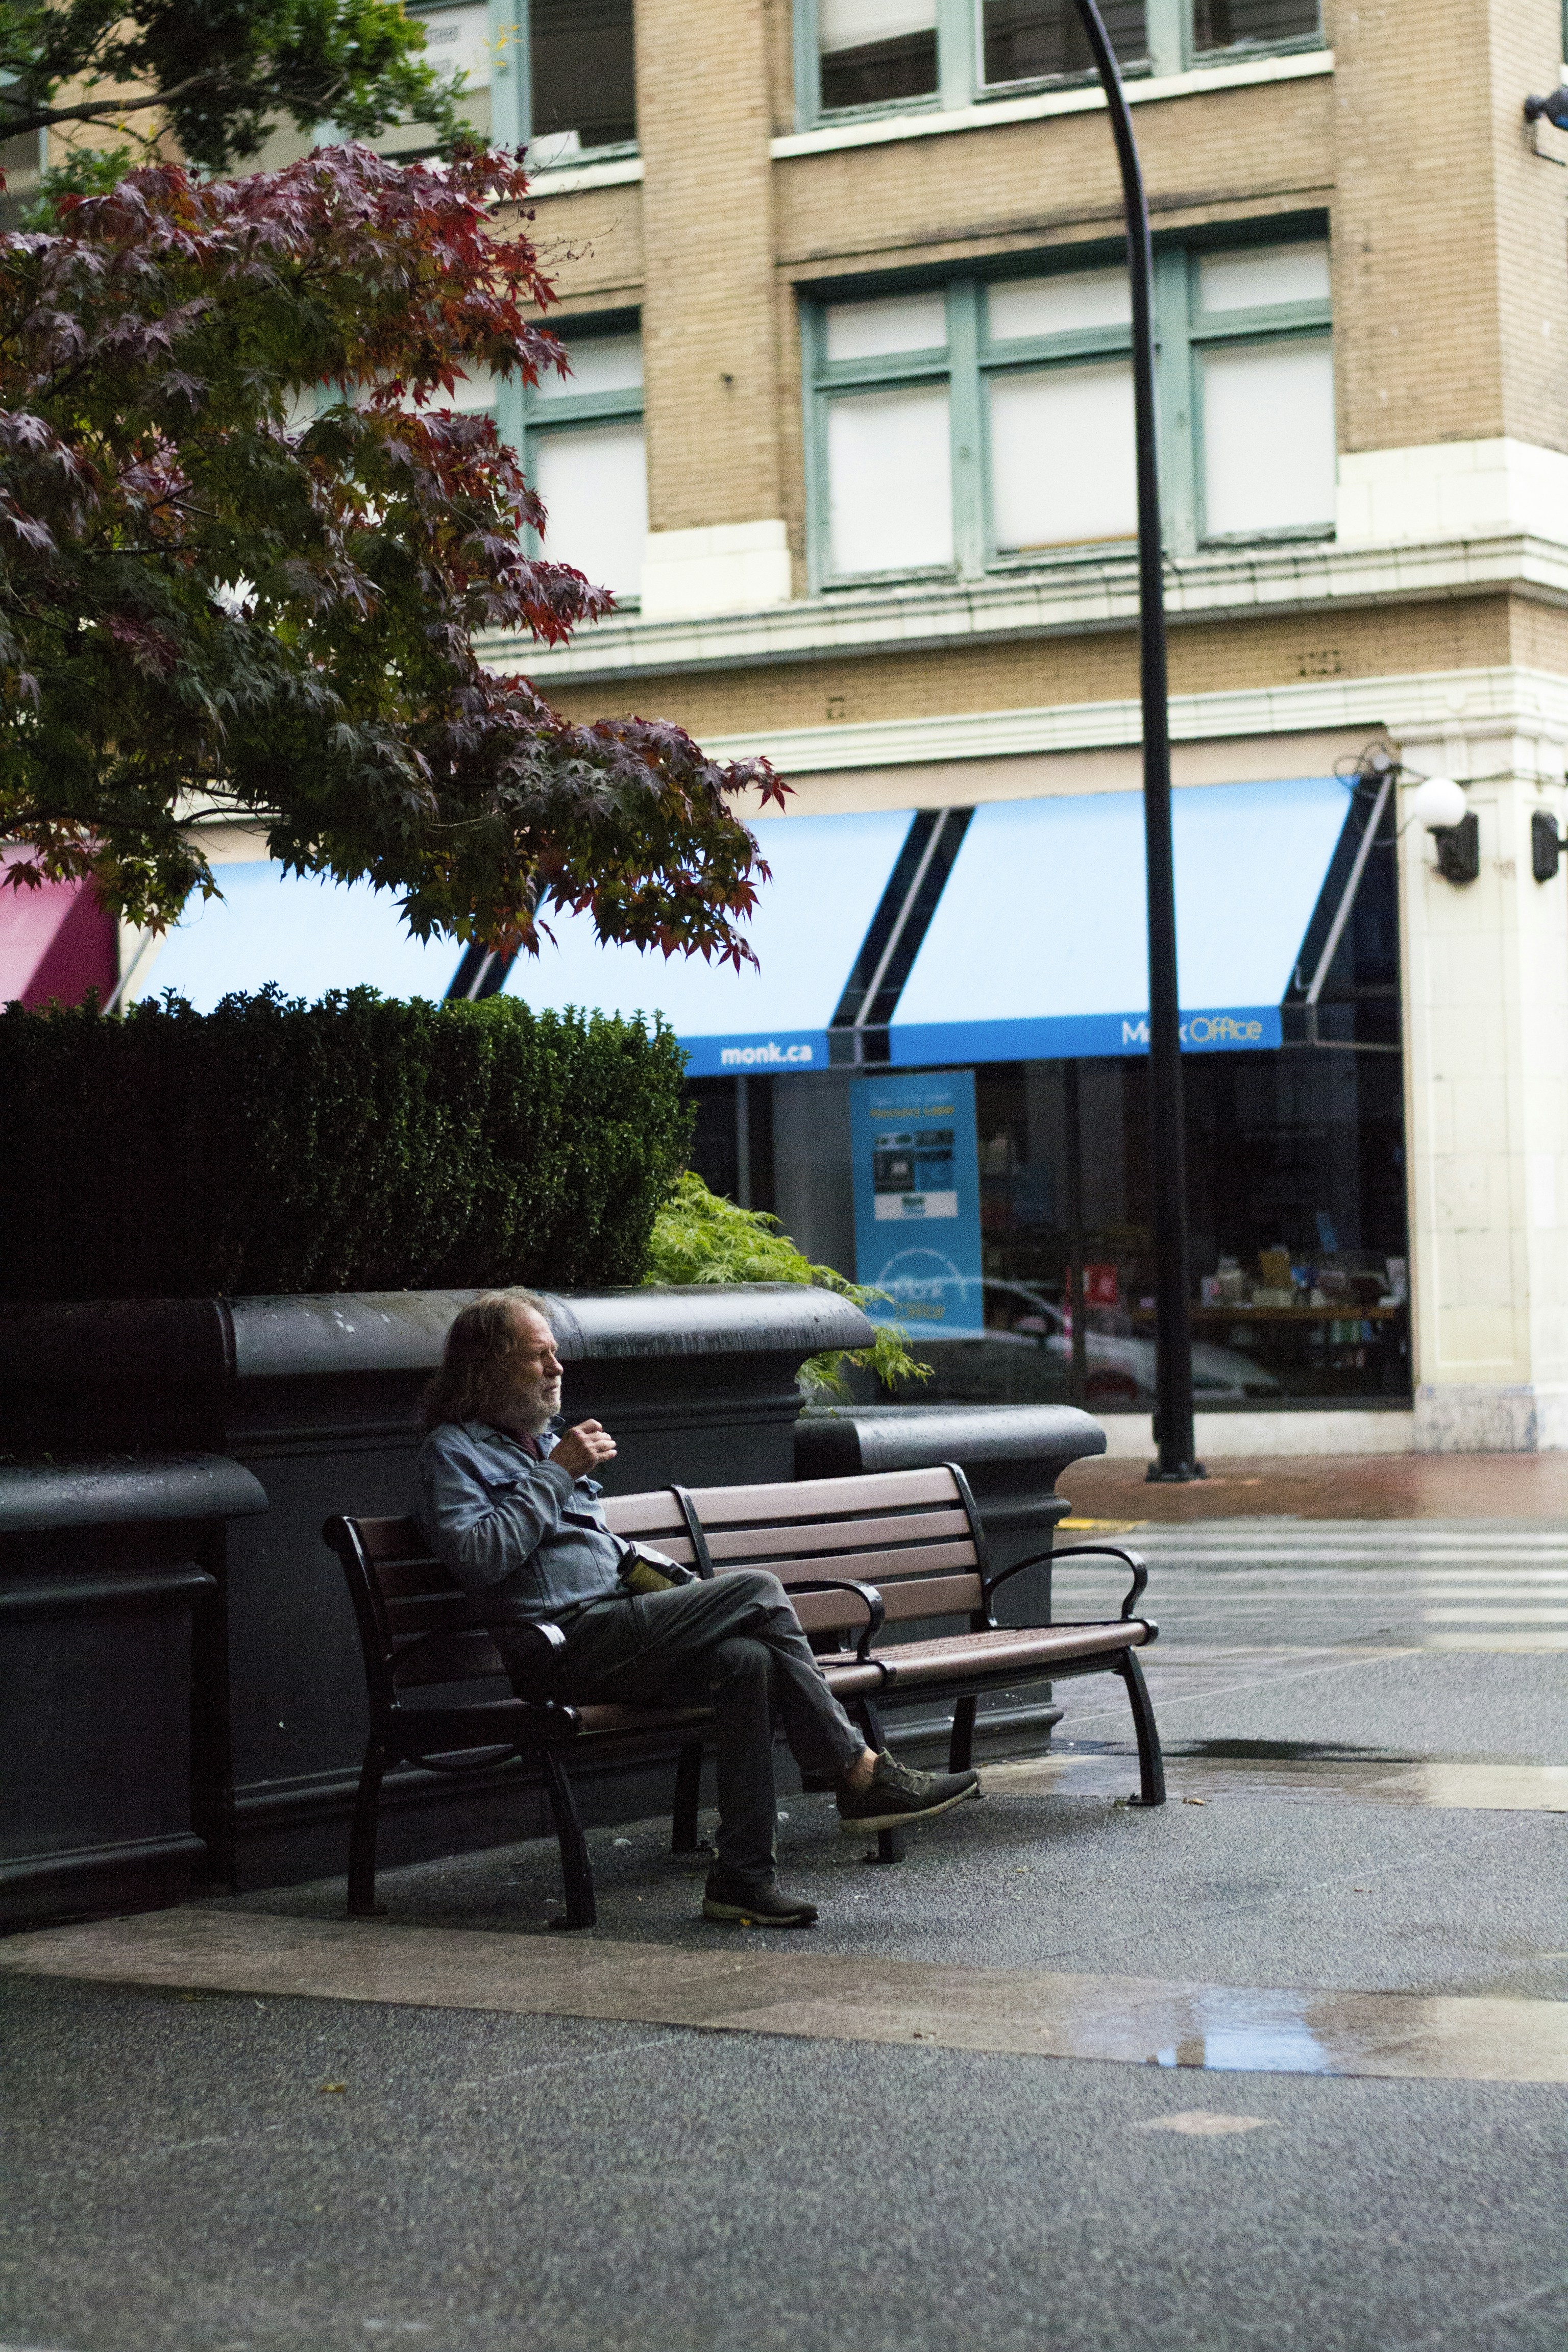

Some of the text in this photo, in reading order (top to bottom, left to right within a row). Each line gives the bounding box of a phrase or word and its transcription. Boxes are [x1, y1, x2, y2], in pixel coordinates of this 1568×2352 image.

[1123, 1017, 1262, 1044] Mk Office
[721, 1041, 813, 1065] monk.ca
